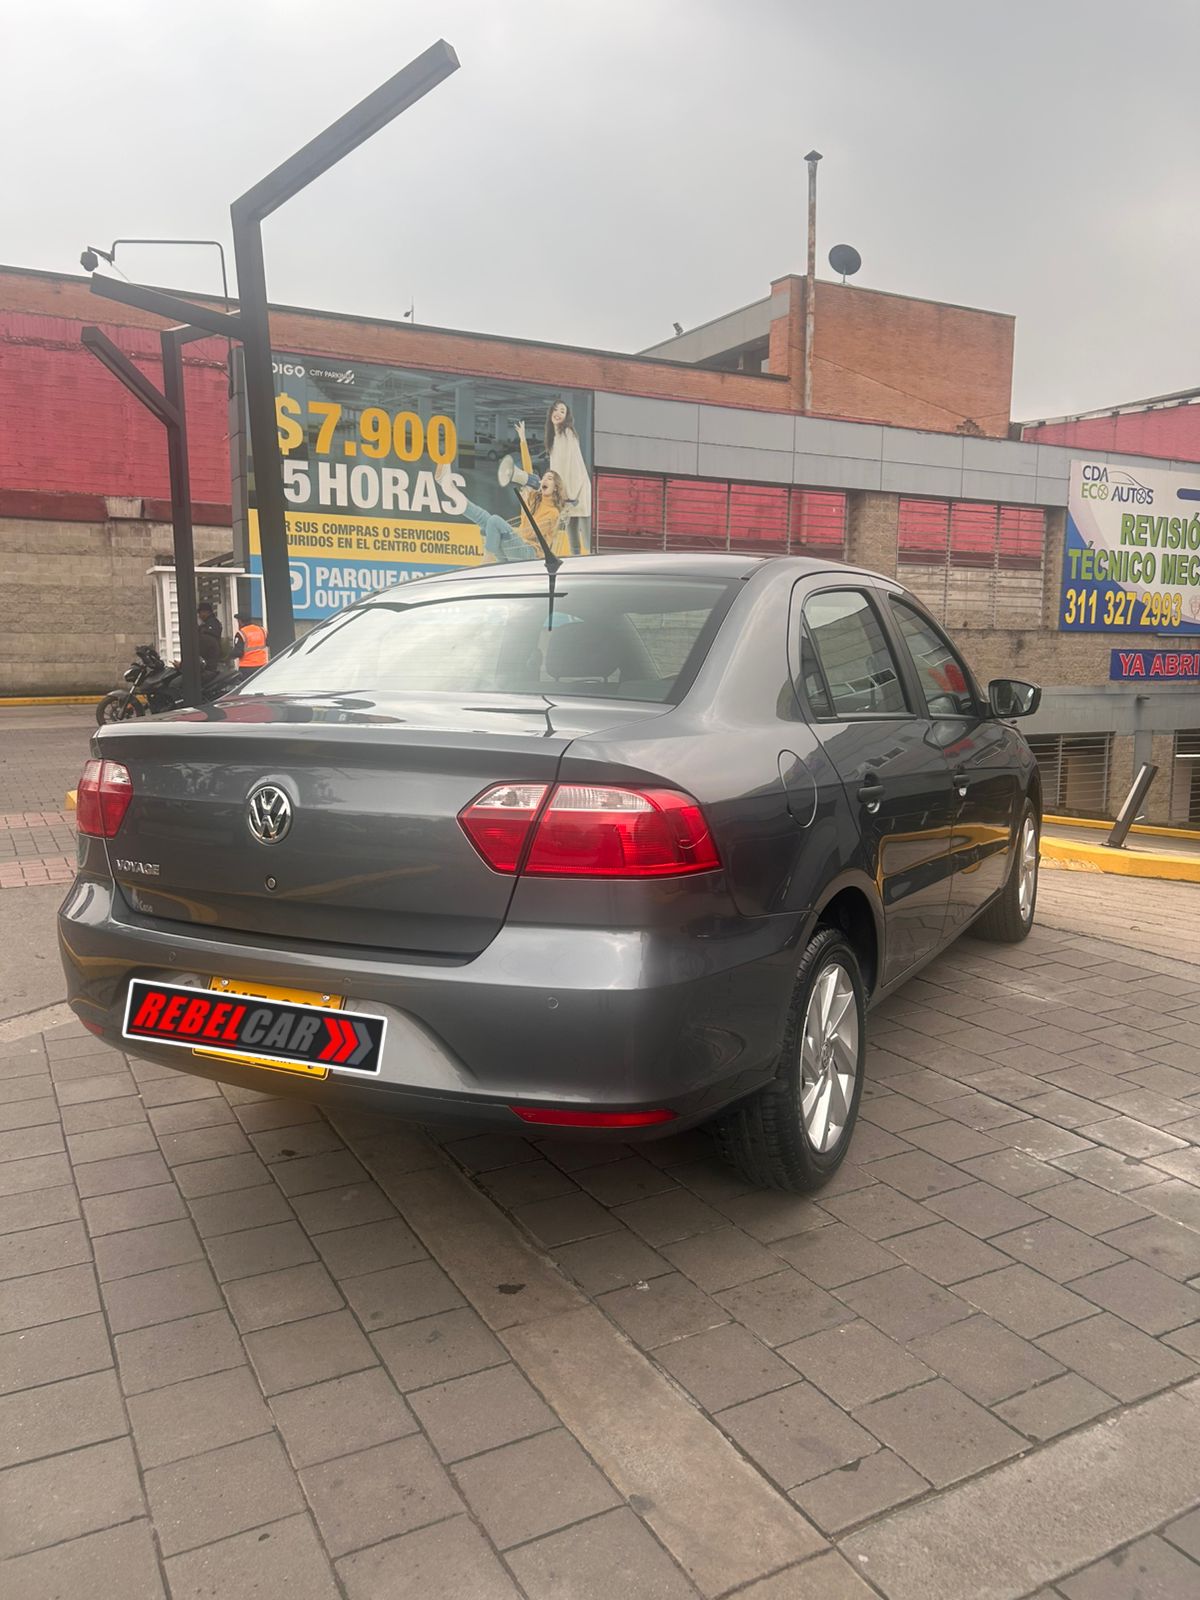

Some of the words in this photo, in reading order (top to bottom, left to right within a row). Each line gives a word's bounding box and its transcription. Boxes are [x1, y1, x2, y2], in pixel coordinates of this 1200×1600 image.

[1082, 465, 1108, 482] CDA
[283, 459, 311, 504] 5
[318, 464, 468, 516] HORAS
[1111, 487, 1154, 505] AUTOS
[294, 521, 319, 533] SUS
[322, 523, 379, 538] COMPRAS
[382, 527, 390, 539] O
[394, 528, 450, 542] SERVICIOS
[337, 537, 353, 549] EN
[356, 538, 370, 550] EL
[373, 539, 417, 553] CENTRO
[420, 542, 484, 557] COMERCIAL.
[1068, 541, 1156, 584] TÉCNICO
[1160, 553, 1200, 587] MEC
[1065, 588, 1098, 625] 311
[1104, 590, 1137, 625] 327
[1140, 592, 1182, 627] 2993
[1119, 653, 1146, 677] YA
[116, 859, 160, 876] VOYAGE
